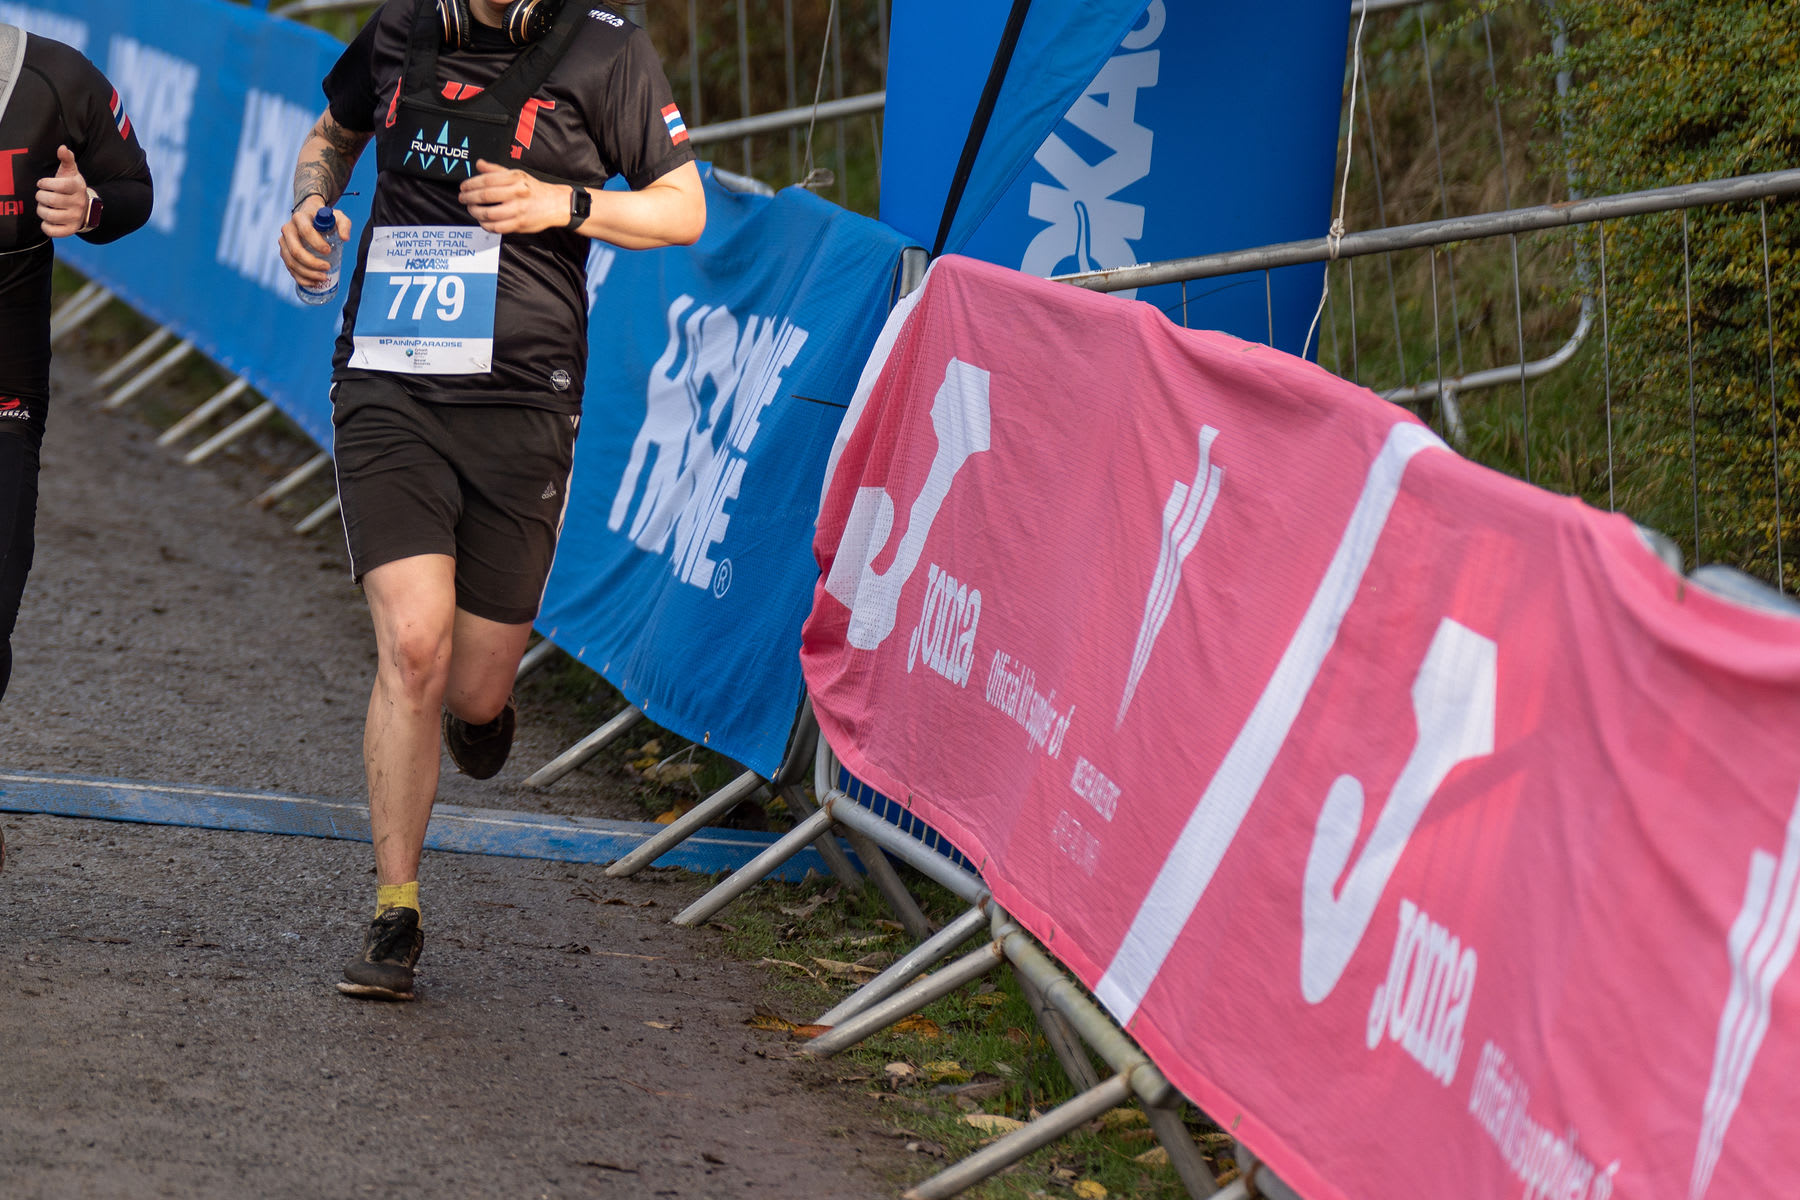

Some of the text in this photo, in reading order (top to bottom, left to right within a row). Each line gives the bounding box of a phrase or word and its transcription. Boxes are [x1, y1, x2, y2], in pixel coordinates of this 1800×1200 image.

[410, 140, 470, 160] RUNITUDE
[1019, 49, 1161, 300] OKA
[392, 231, 473, 239] HOKA ONE ONE
[395, 240, 468, 248] WINTER TRAIL
[387, 249, 476, 257] HALF MARATHON
[405, 258, 436, 270] HOKA
[387, 275, 465, 321] 779
[1048, 705, 1077, 760] of
